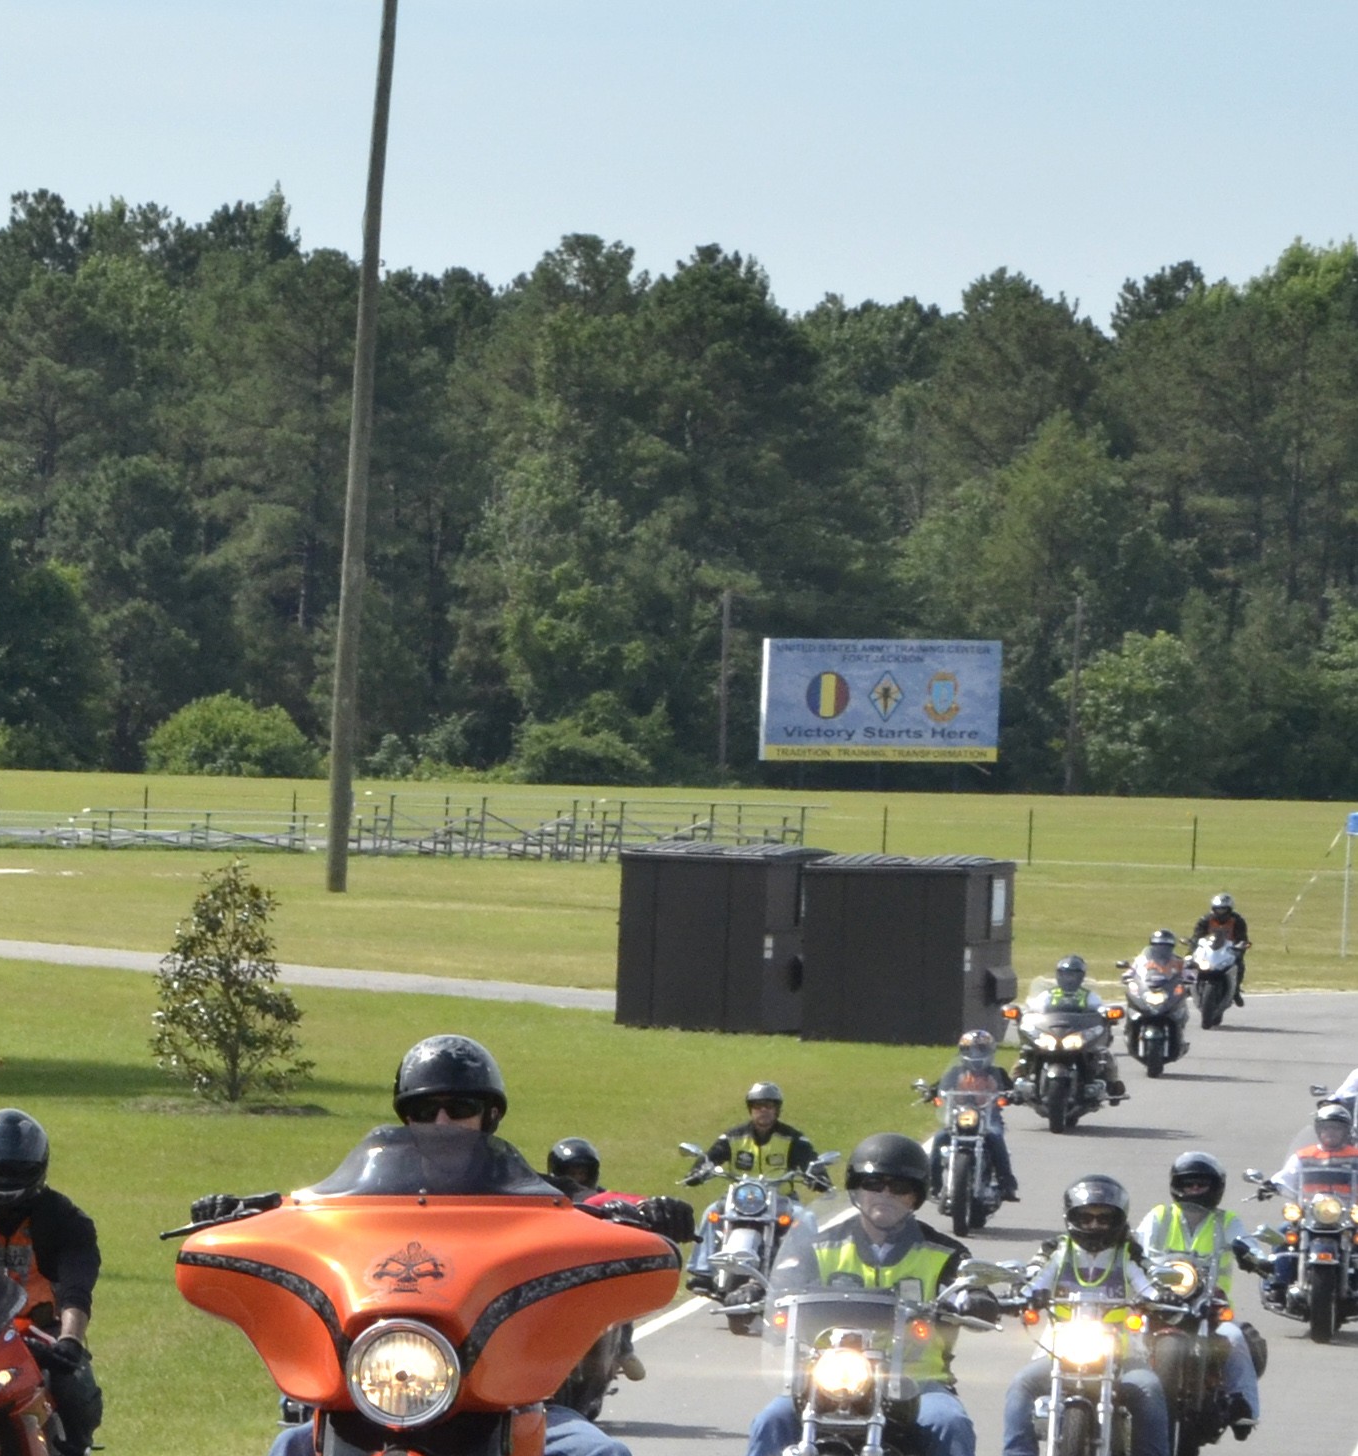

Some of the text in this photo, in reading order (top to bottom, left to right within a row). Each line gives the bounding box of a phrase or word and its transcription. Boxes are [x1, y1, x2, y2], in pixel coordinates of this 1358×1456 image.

[777, 644, 990, 654] UNITED STATES ARMY TRAINING CENTER
[842, 654, 924, 664] FORT JACKSON
[784, 726, 979, 741] Victory Starts Here
[892, 749, 987, 758] TRANSFORMATION
